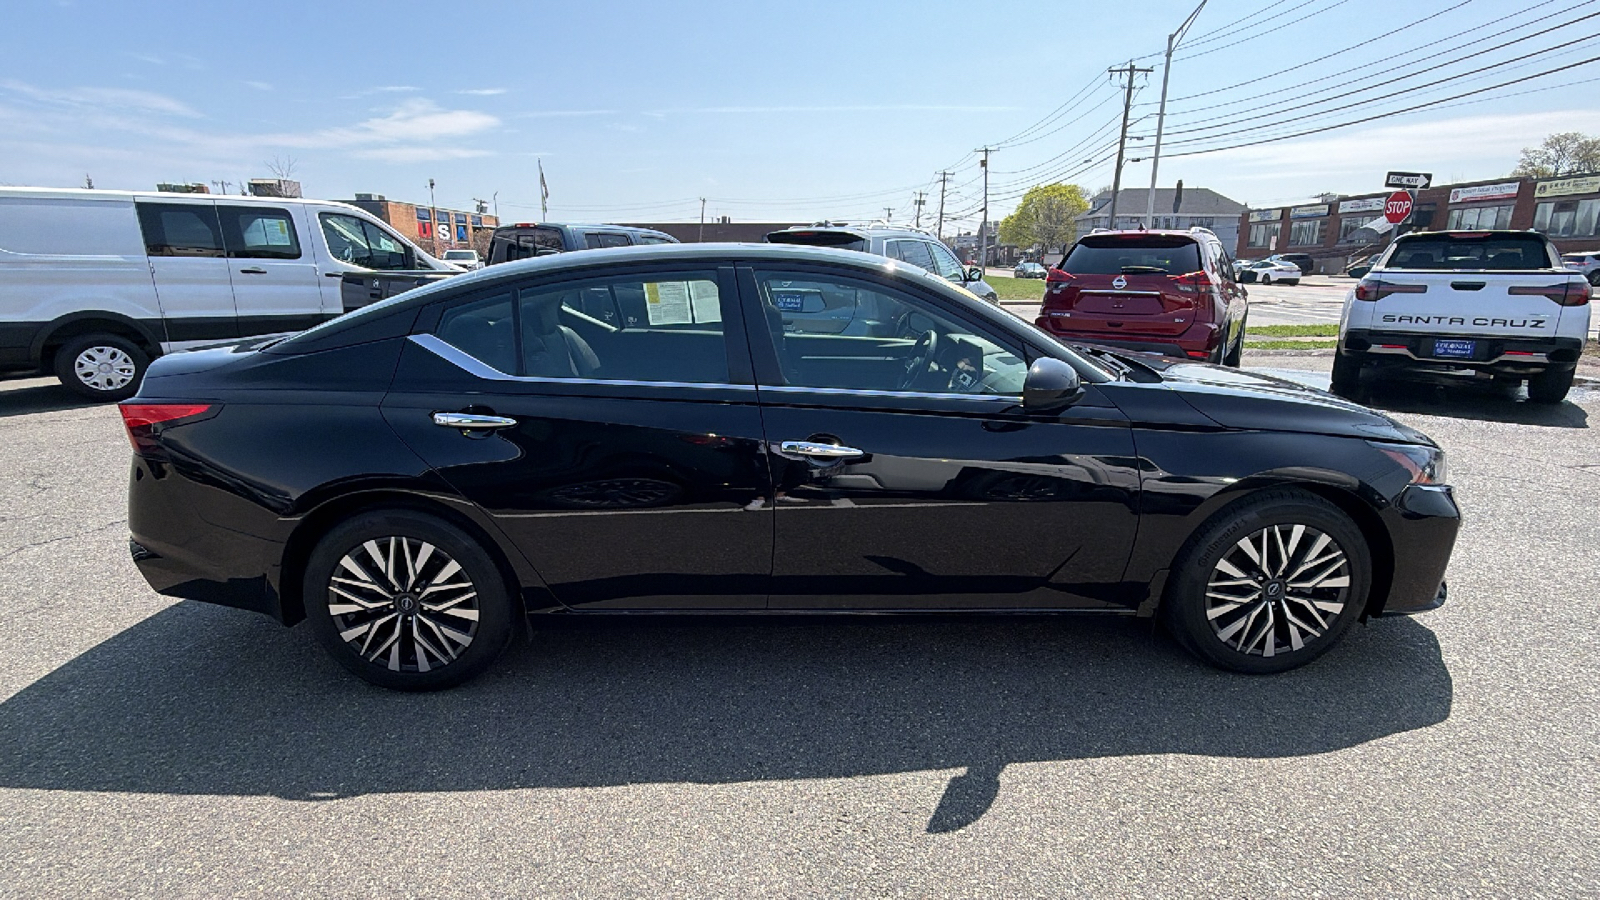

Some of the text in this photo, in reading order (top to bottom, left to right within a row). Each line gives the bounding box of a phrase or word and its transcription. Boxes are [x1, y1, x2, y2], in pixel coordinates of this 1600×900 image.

[1391, 176, 1419, 185] ONE WAY
[1386, 200, 1411, 214] STOP
[1382, 314, 1546, 329] SANTA CRUZ
